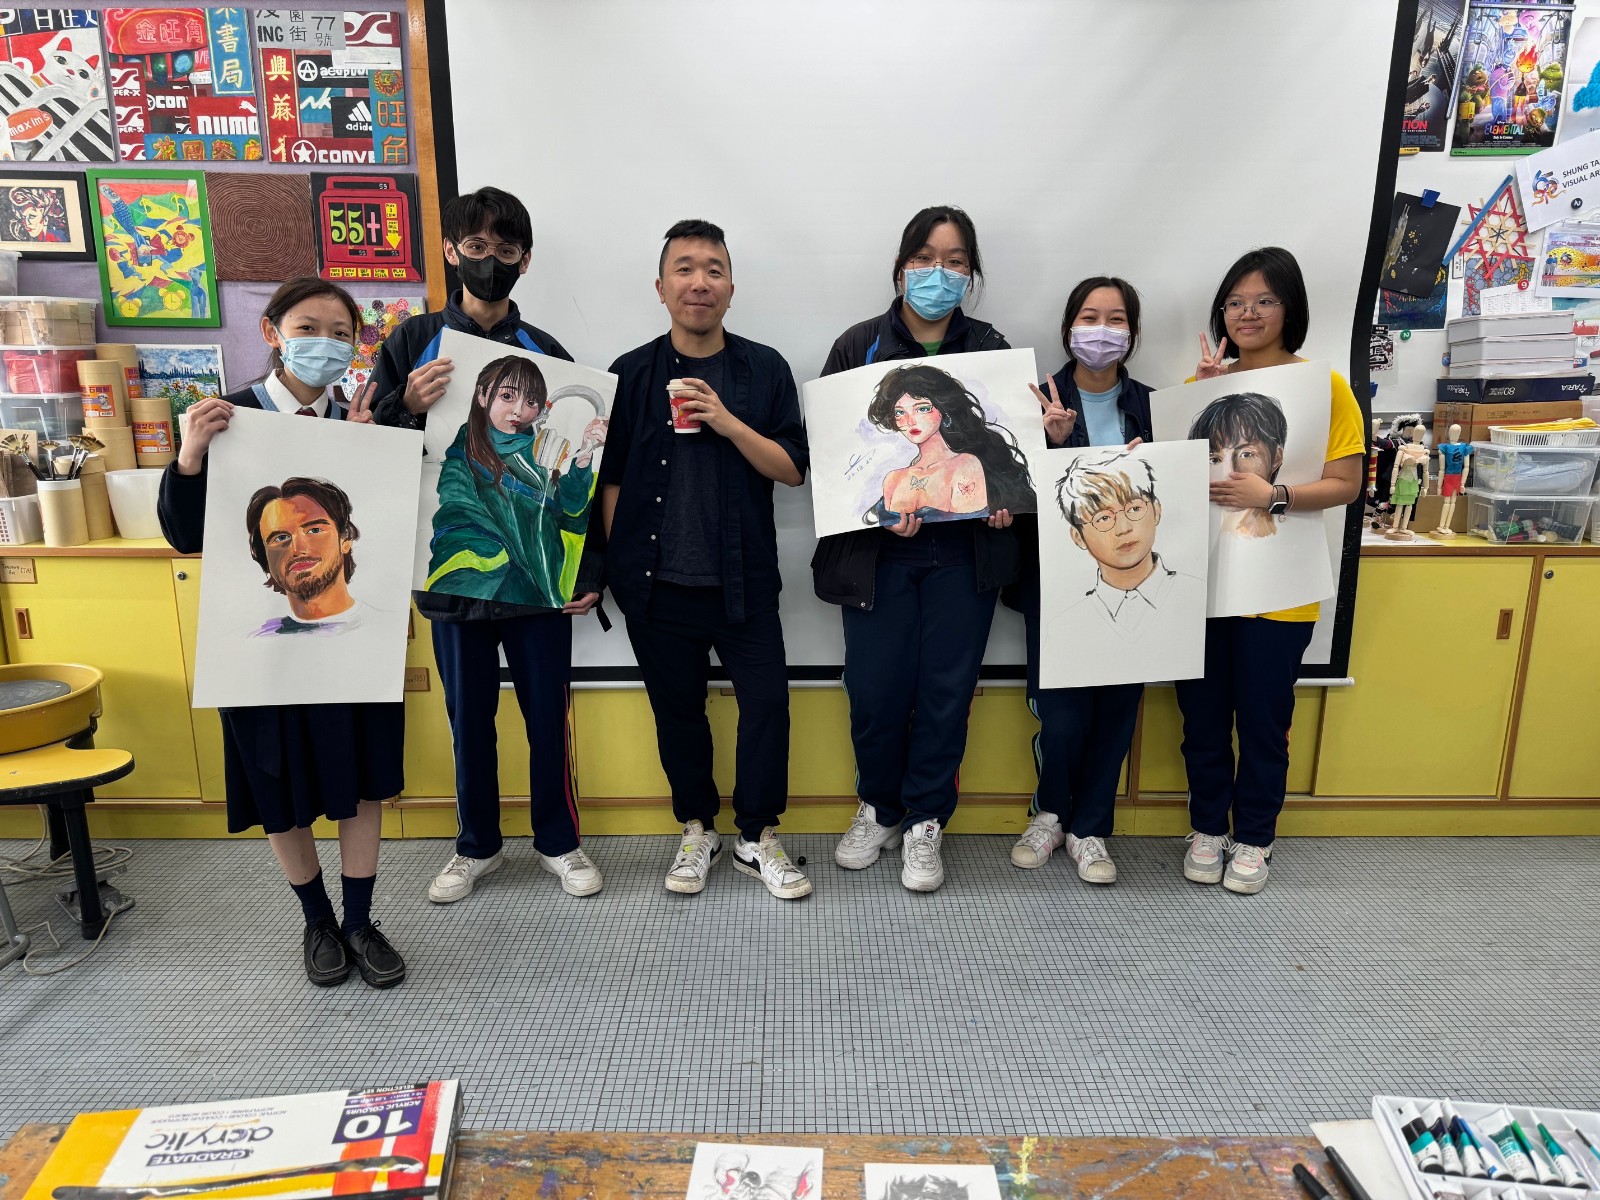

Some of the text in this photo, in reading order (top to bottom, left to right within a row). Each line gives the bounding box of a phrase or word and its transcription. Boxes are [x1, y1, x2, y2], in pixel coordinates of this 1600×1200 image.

[136, 18, 204, 44] 金旺角
[310, 16, 336, 31] 77
[258, 26, 284, 42] ING
[156, 96, 188, 108] CON
[378, 101, 407, 163] 旺角
[1484, 123, 1524, 135] ELEMENTAL
[1562, 163, 1589, 178] SHUNG
[1562, 169, 1600, 188] VISUAL AR
[346, 1100, 421, 1115] ACRYLIC COLOURS
[343, 1110, 412, 1140] 10
[145, 1123, 274, 1152] acrylic
[150, 1150, 246, 1166] GRADUATE
